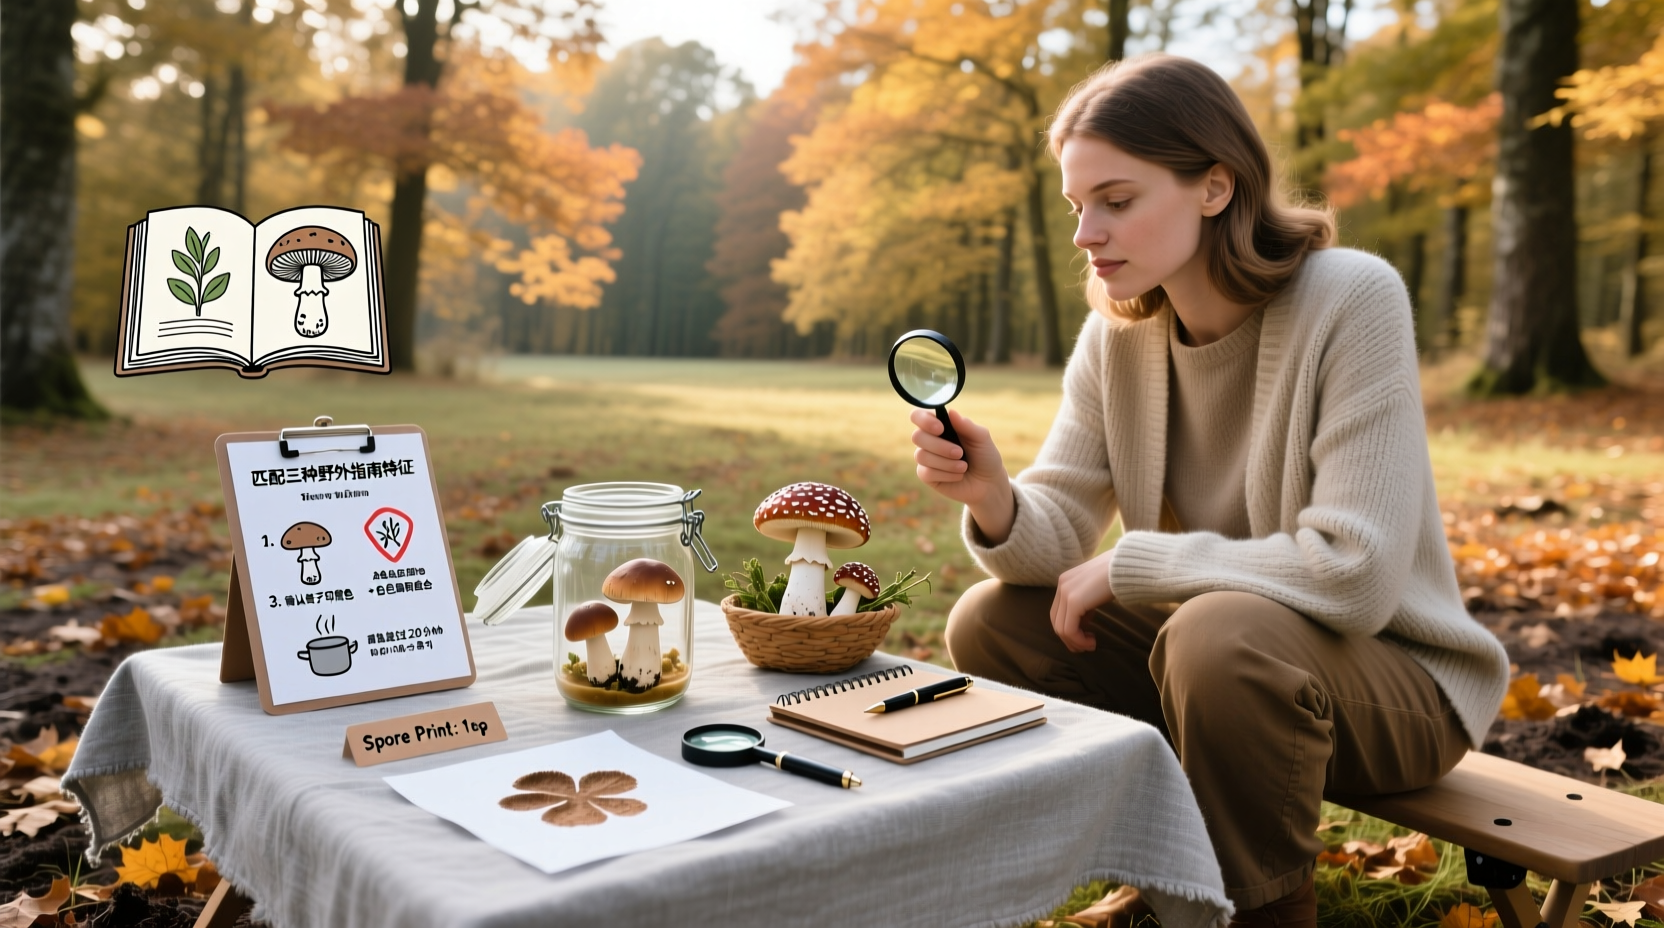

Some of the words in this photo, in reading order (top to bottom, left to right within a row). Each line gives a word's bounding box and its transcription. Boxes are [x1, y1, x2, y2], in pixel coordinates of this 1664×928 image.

[251, 459, 415, 486] 匹配三种野外指南特征
[261, 534, 275, 548] 1.
[268, 595, 282, 608] 3.
[362, 732, 411, 753] Spore
[414, 723, 459, 742] Print:
